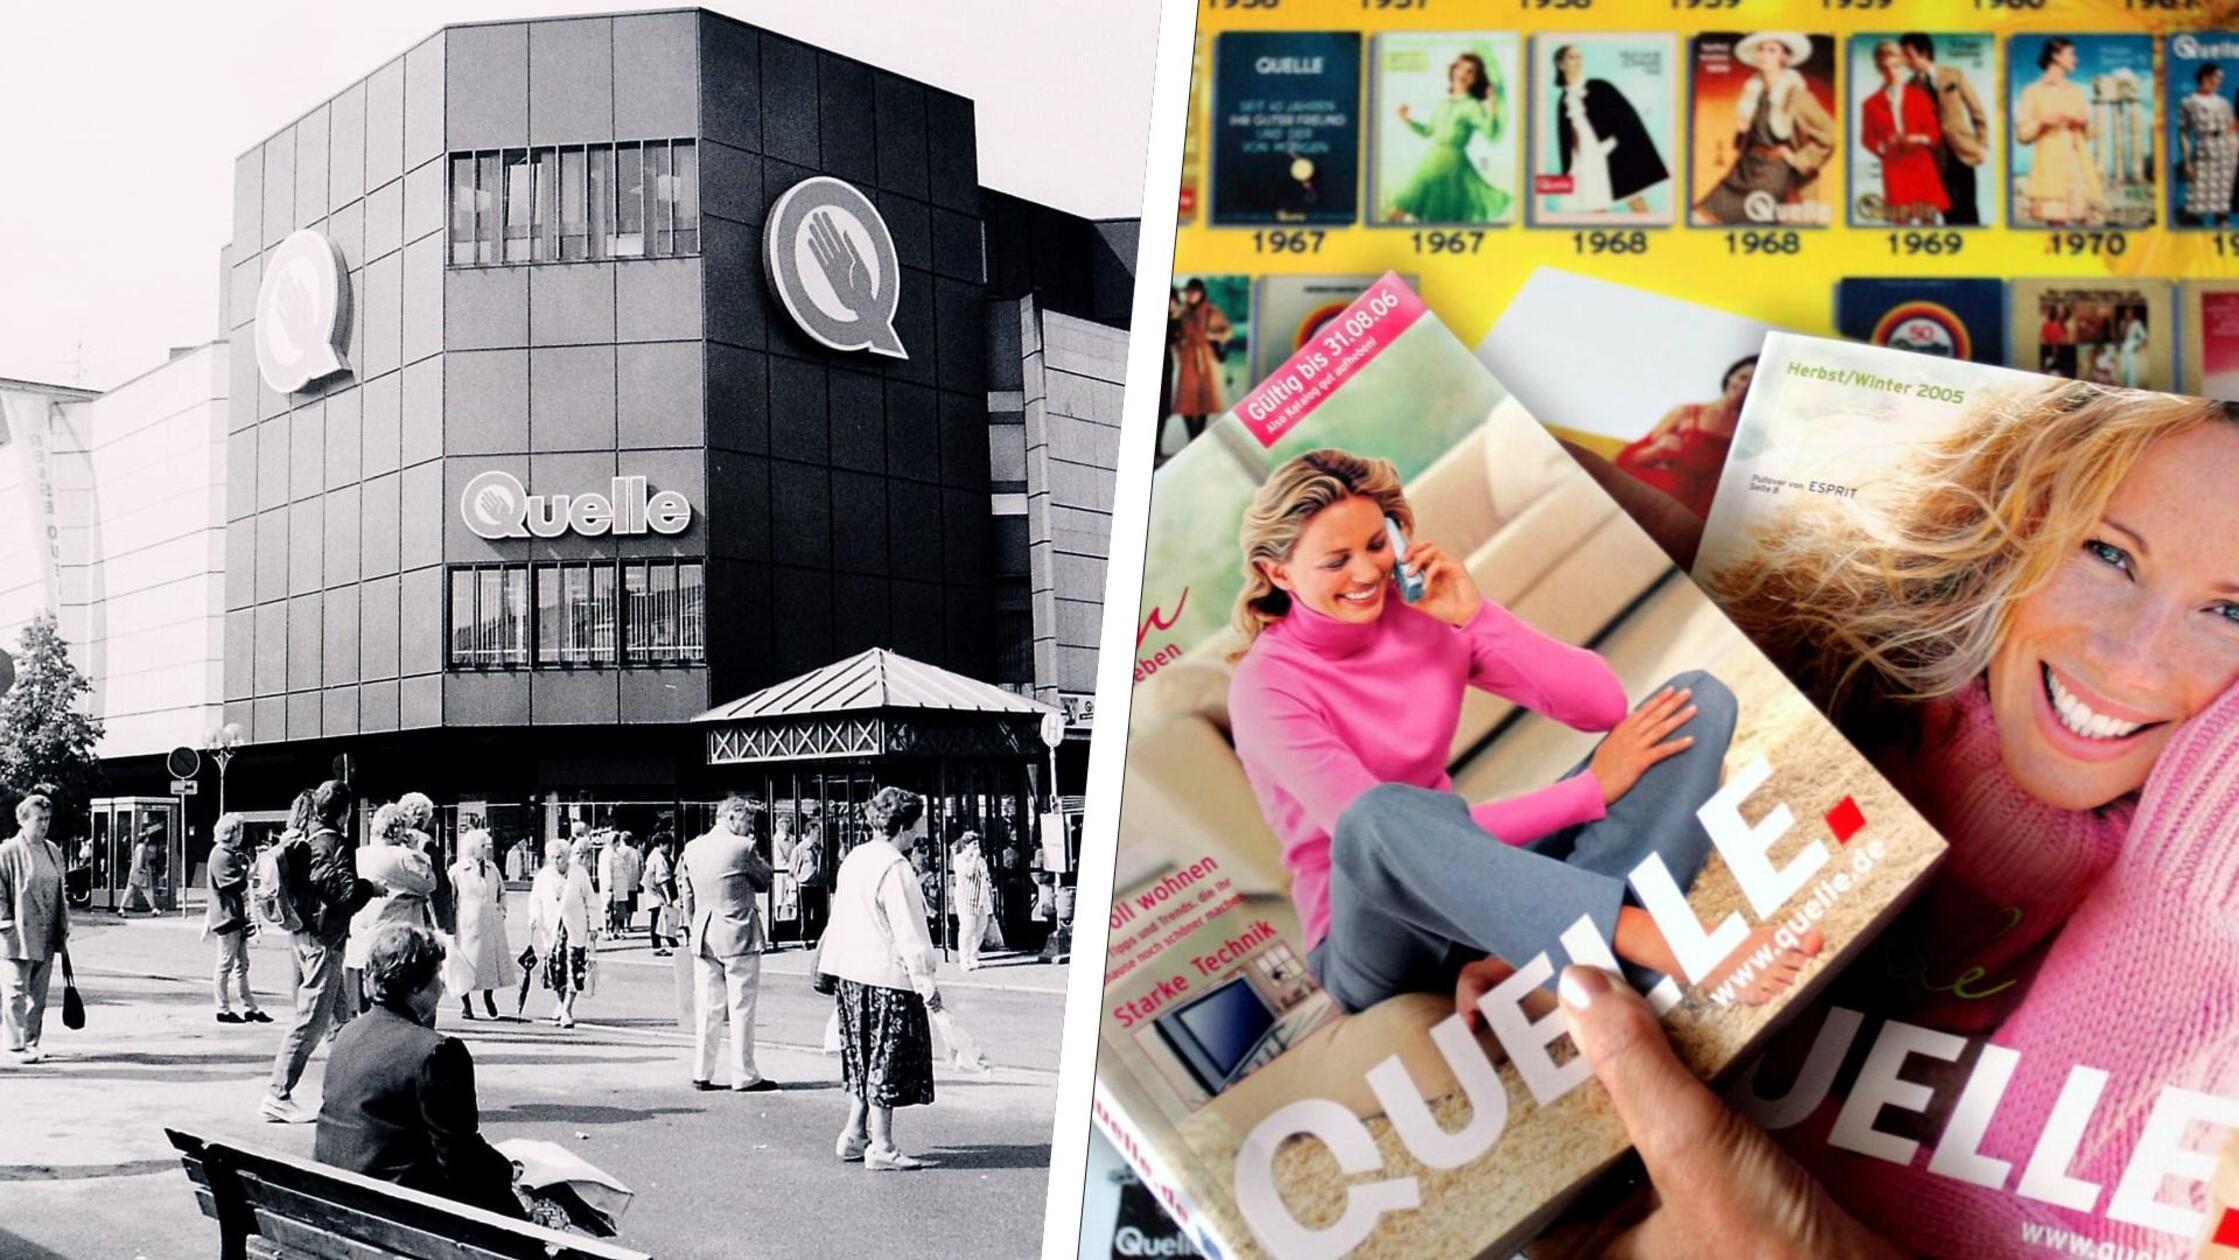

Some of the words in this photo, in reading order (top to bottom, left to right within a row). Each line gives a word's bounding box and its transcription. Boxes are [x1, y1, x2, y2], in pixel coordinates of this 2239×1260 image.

[1255, 56, 1325, 74] QUELLE
[1744, 190, 1831, 222] Quelle
[1252, 231, 1326, 254] 1967
[1411, 231, 1485, 254] 1967
[1573, 231, 1648, 254] 1968
[1725, 232, 1800, 254] 1968
[1887, 232, 1963, 255] 1969
[2050, 232, 2127, 256] 1970
[1248, 375, 1304, 421] Gültig
[1297, 352, 1329, 380] bis
[1324, 289, 1398, 357] 31.08.06
[1265, 415, 1287, 434] Also
[1285, 387, 1321, 417] Katalog
[1318, 373, 1335, 391] gut
[1335, 336, 1378, 376] aufheben!
[1787, 361, 1912, 395] Herbst/Winter
[1917, 383, 1965, 404] 2005
[461, 470, 691, 539] Quelle
[1808, 481, 1858, 499] ESPRIT
[1136, 856, 1219, 911] wohnen
[1137, 942, 1163, 962] noch
[1163, 917, 1204, 946] schöner
[1204, 892, 1247, 921] machen
[1138, 922, 1159, 940] und
[1198, 889, 1215, 903] die
[1215, 878, 1232, 892] Ihr
[1709, 840, 1885, 1006] www.quelle.de
[1113, 975, 1190, 1029] Starke
[1190, 920, 1277, 977] Technik
